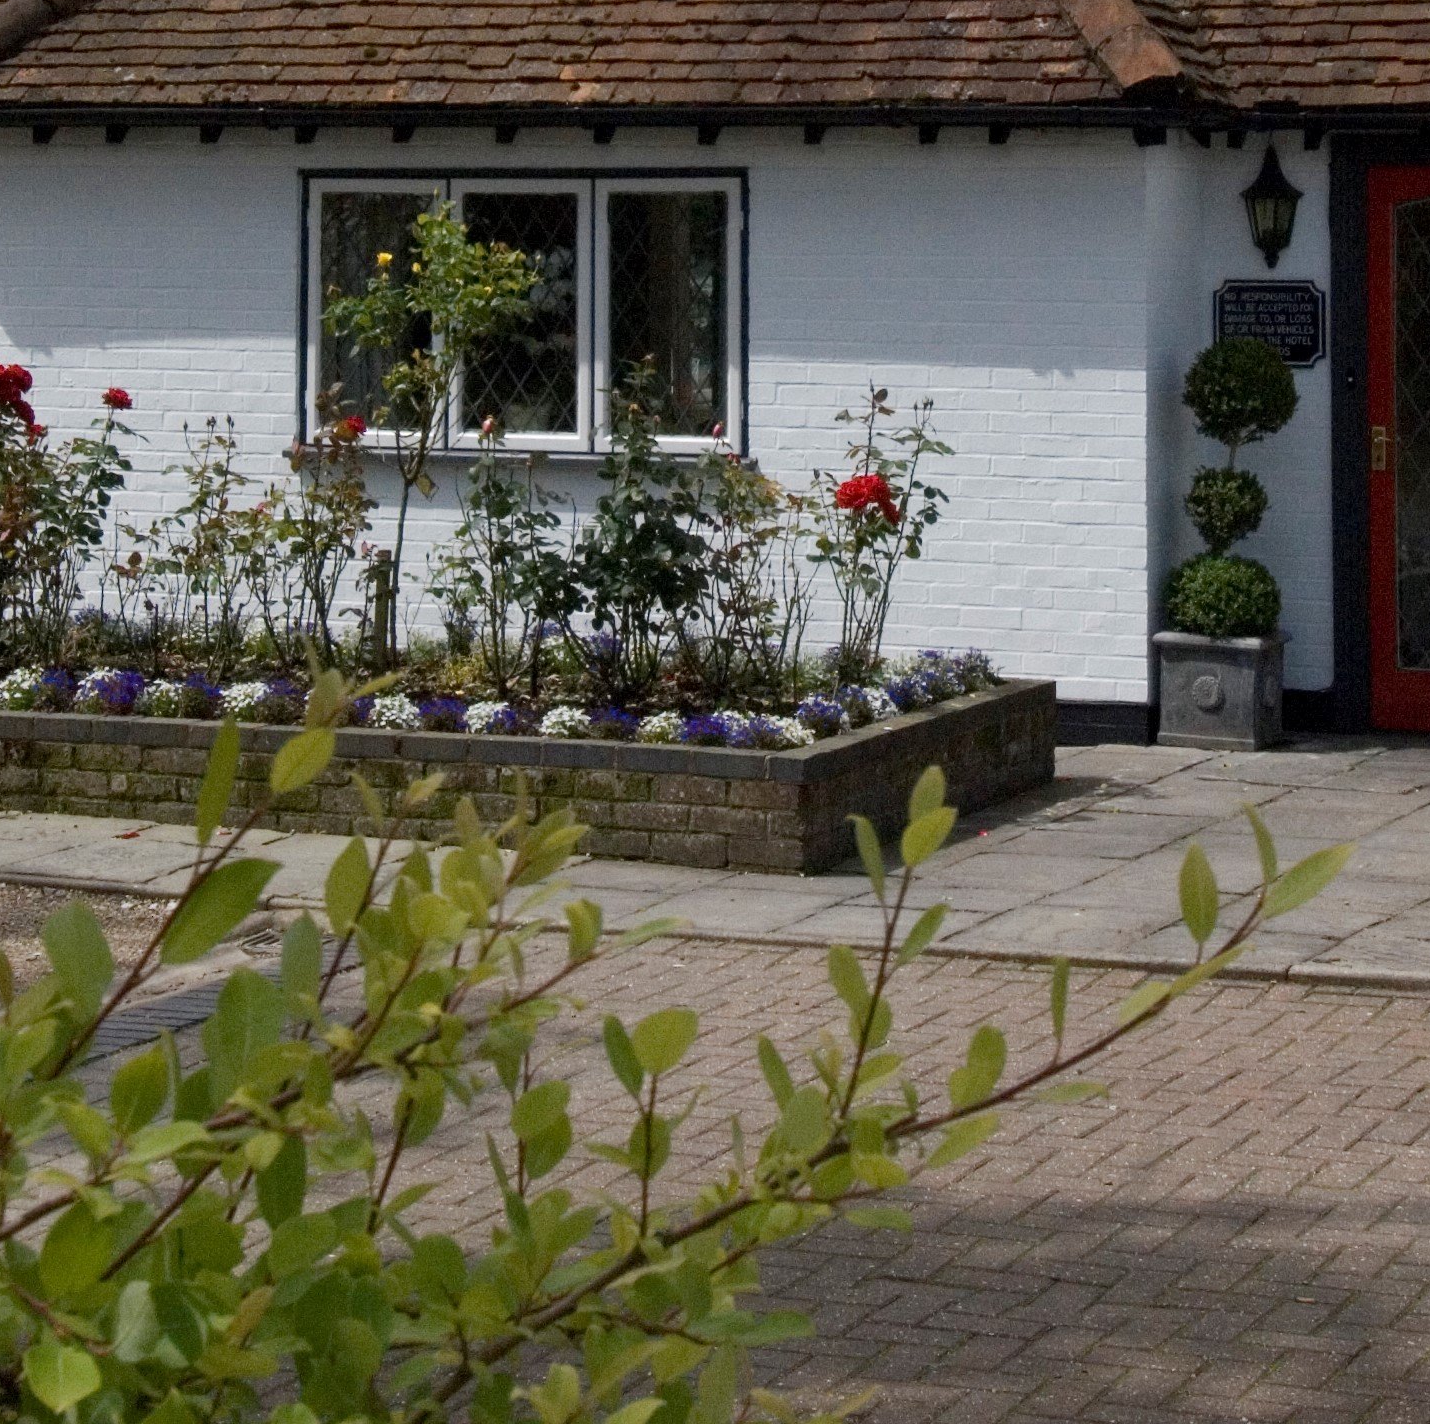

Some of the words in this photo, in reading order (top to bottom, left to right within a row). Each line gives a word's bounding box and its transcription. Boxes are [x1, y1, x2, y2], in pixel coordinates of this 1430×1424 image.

[1240, 292, 1311, 301] RESPONSIBILITY
[1224, 303, 1242, 312] WILL
[1258, 303, 1299, 312] ACCEPTED
[1224, 314, 1256, 323] DAMAGE
[1274, 314, 1286, 323] OR
[1289, 314, 1312, 323] LOSS
[1251, 325, 1275, 334] FROM
[1277, 325, 1315, 335] VEHICLES
[1267, 336, 1282, 345] THE
[1285, 336, 1312, 345] HOTEL
